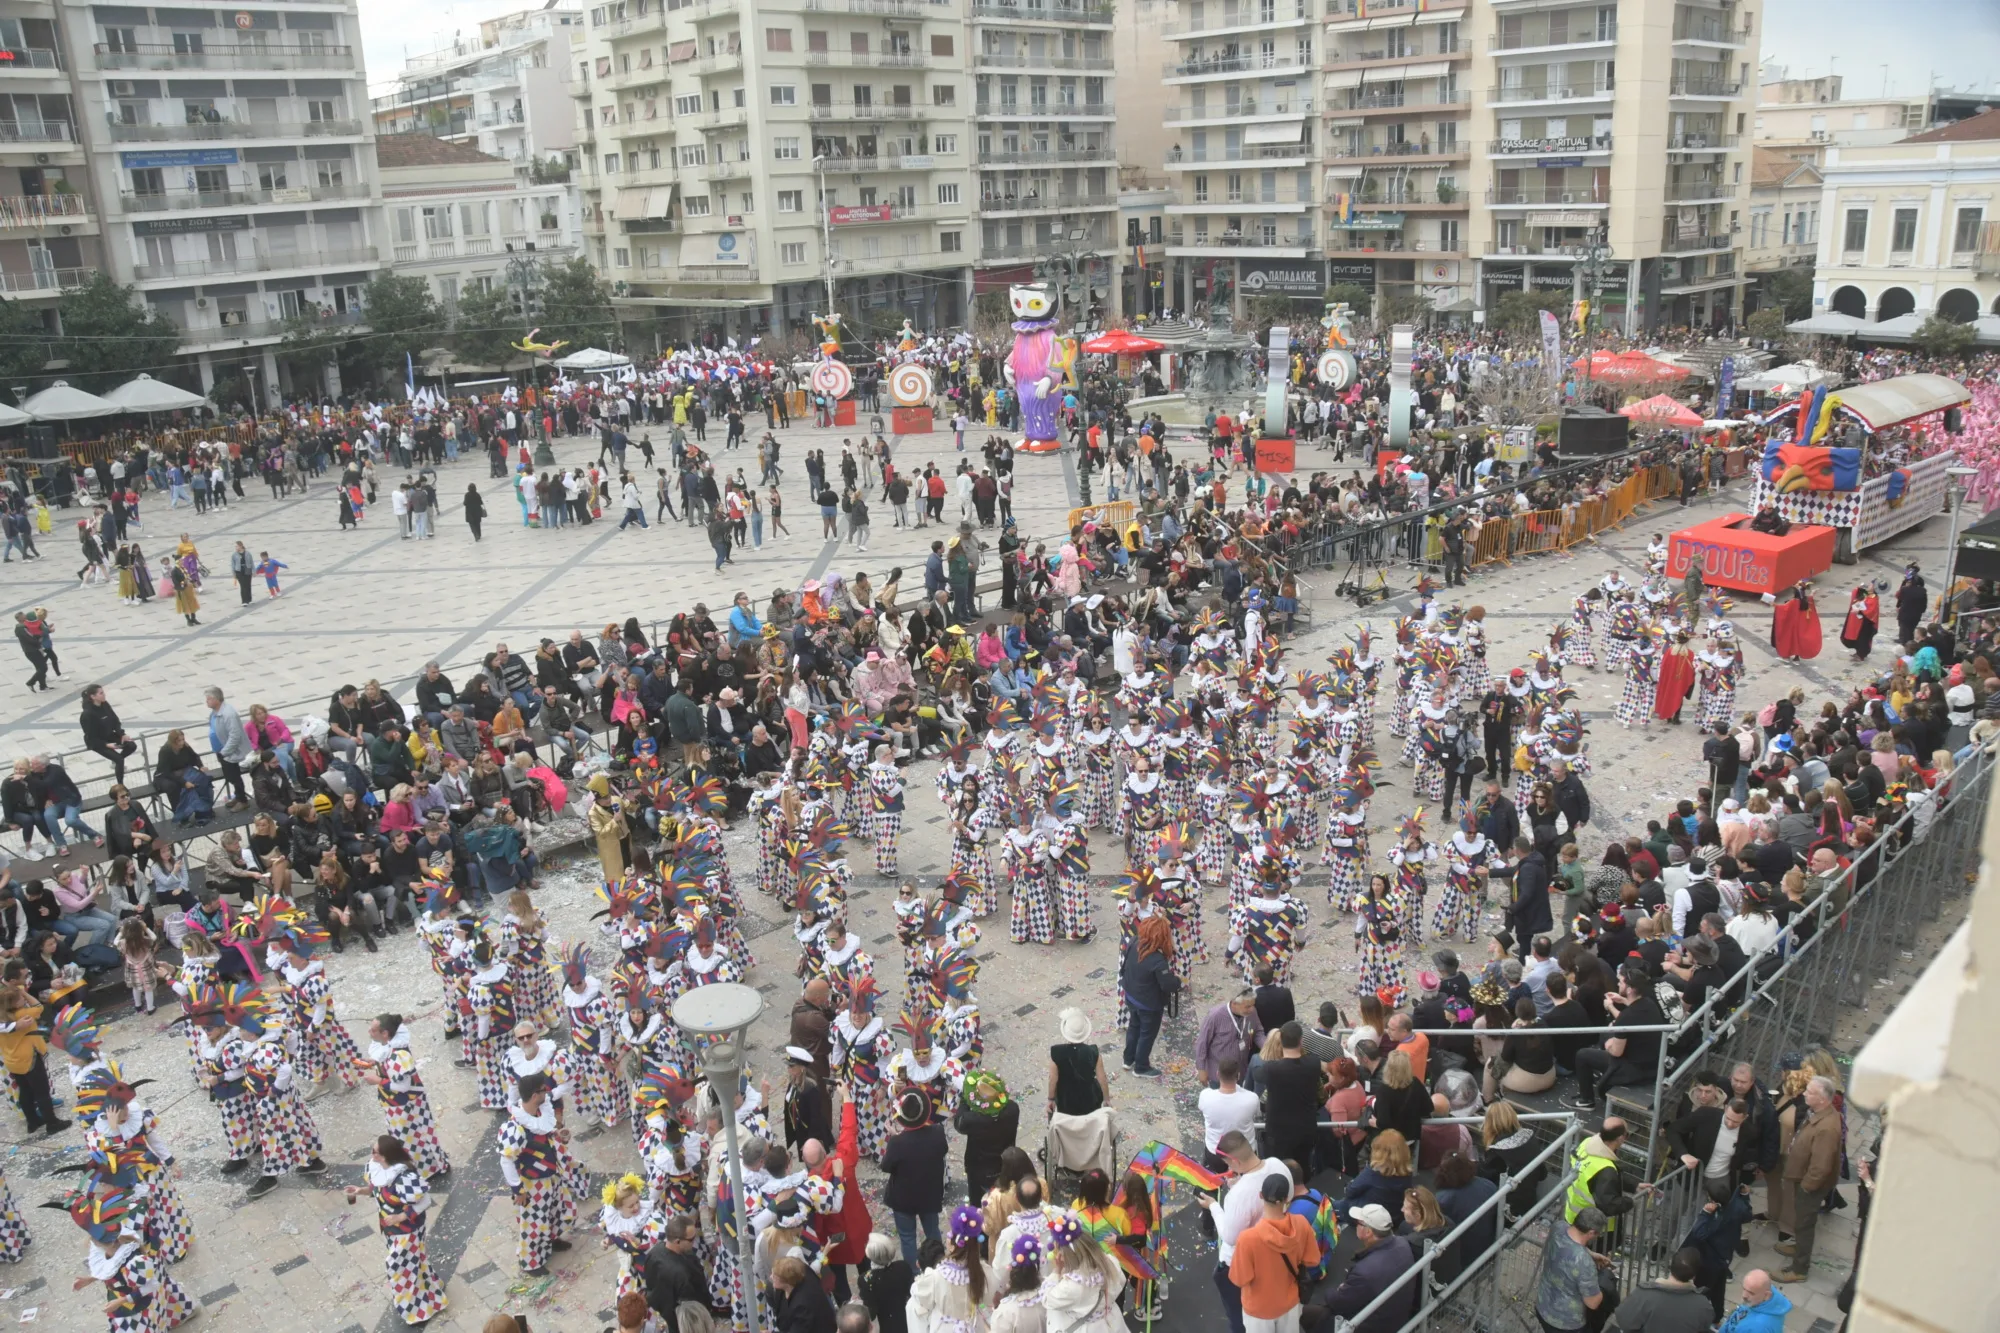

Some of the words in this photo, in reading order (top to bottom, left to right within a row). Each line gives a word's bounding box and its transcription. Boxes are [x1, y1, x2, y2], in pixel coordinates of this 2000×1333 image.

[1501, 139, 1538, 148] MASSAGE
[1558, 137, 1588, 146] RITUAL
[148, 220, 183, 229] ΤΡΙΓΚΑΣ
[188, 218, 213, 226] ΖΙΩΓΑ
[1268, 270, 1317, 283] ΠΑΠΑΔΑΚΗΣ
[1530, 276, 1574, 285] ΦΑΡΜΑΚΕΙΟ
[1674, 539, 1755, 581] GROUP
[1745, 564, 1769, 586] 128
